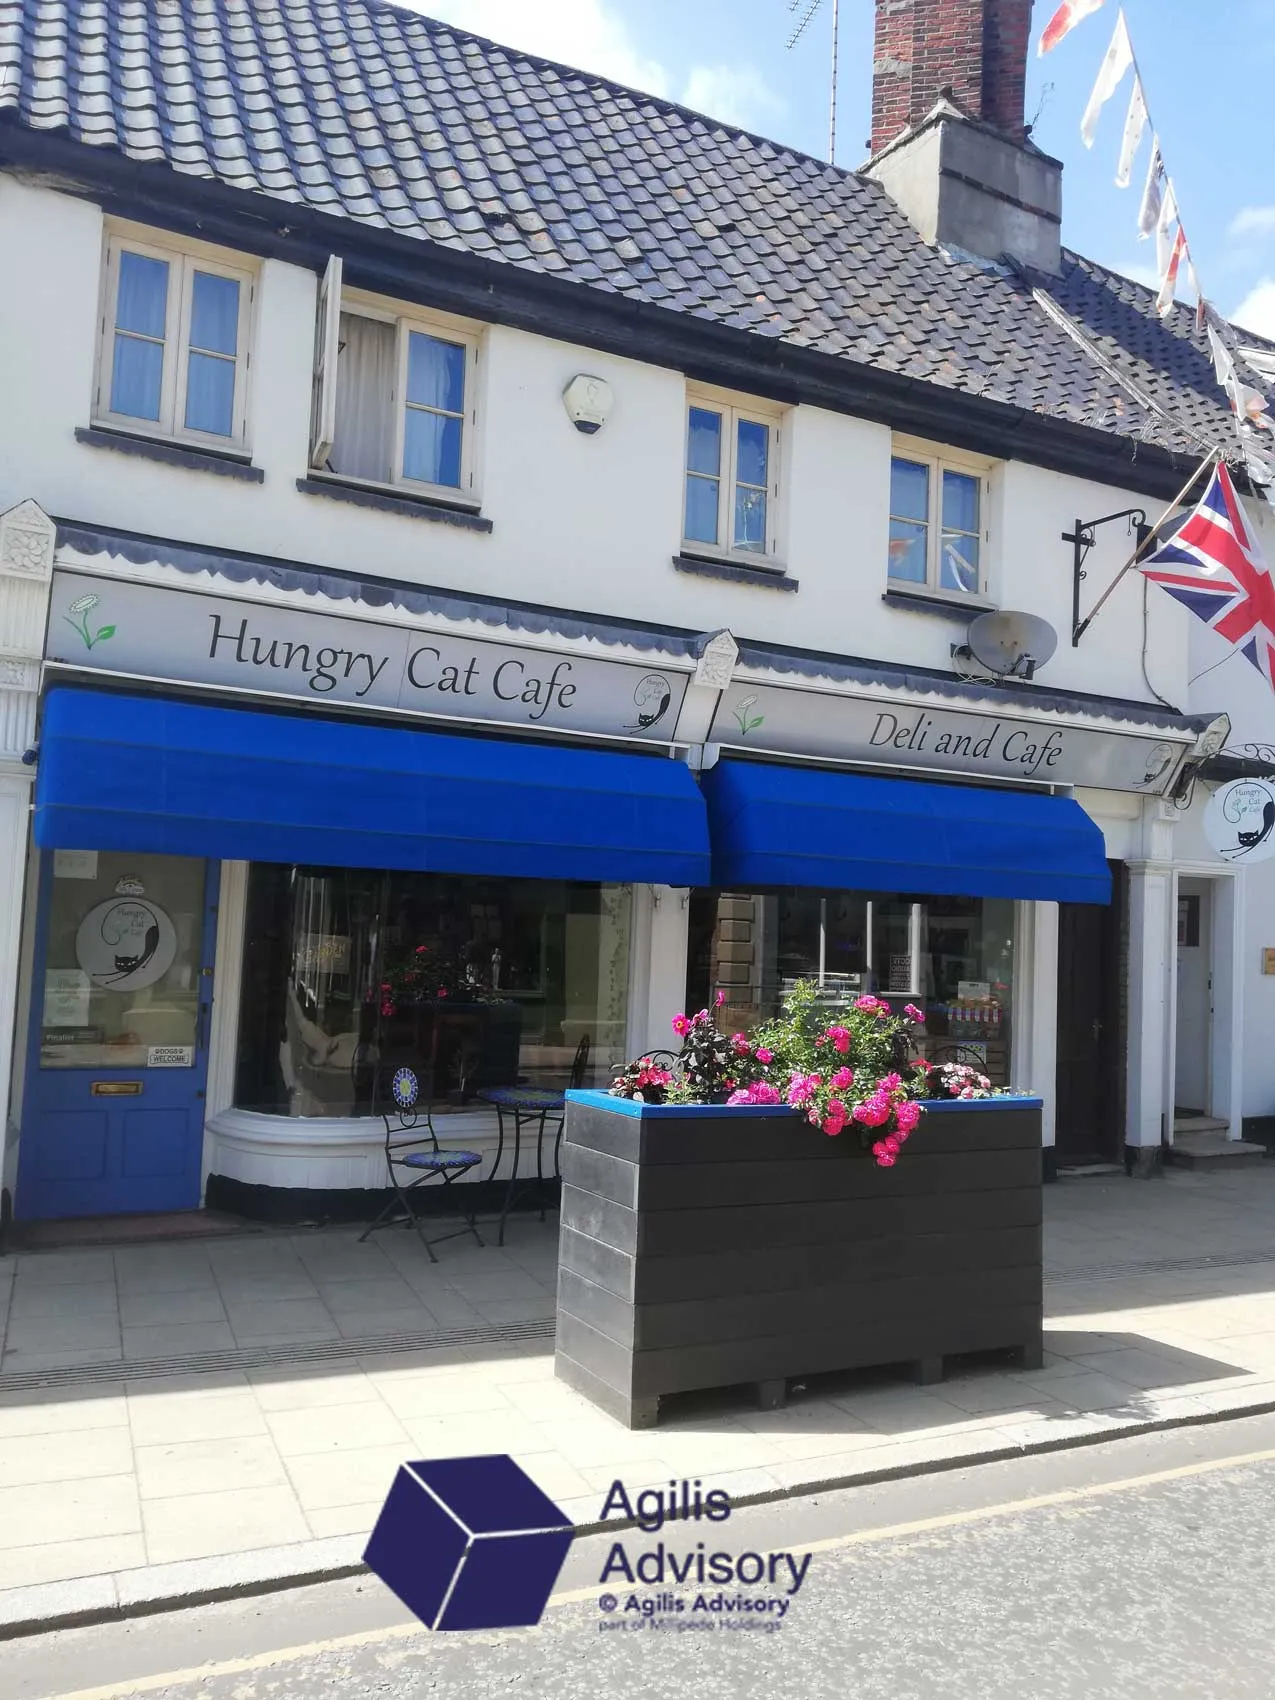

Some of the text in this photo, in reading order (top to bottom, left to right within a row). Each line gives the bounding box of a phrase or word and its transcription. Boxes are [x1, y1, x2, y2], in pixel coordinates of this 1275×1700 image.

[209, 614, 577, 720] Hungry Cat Cafe
[869, 713, 1063, 776] Deli and Cafe
[1235, 789, 1261, 798] Hungry
[117, 908, 146, 919] Hungry
